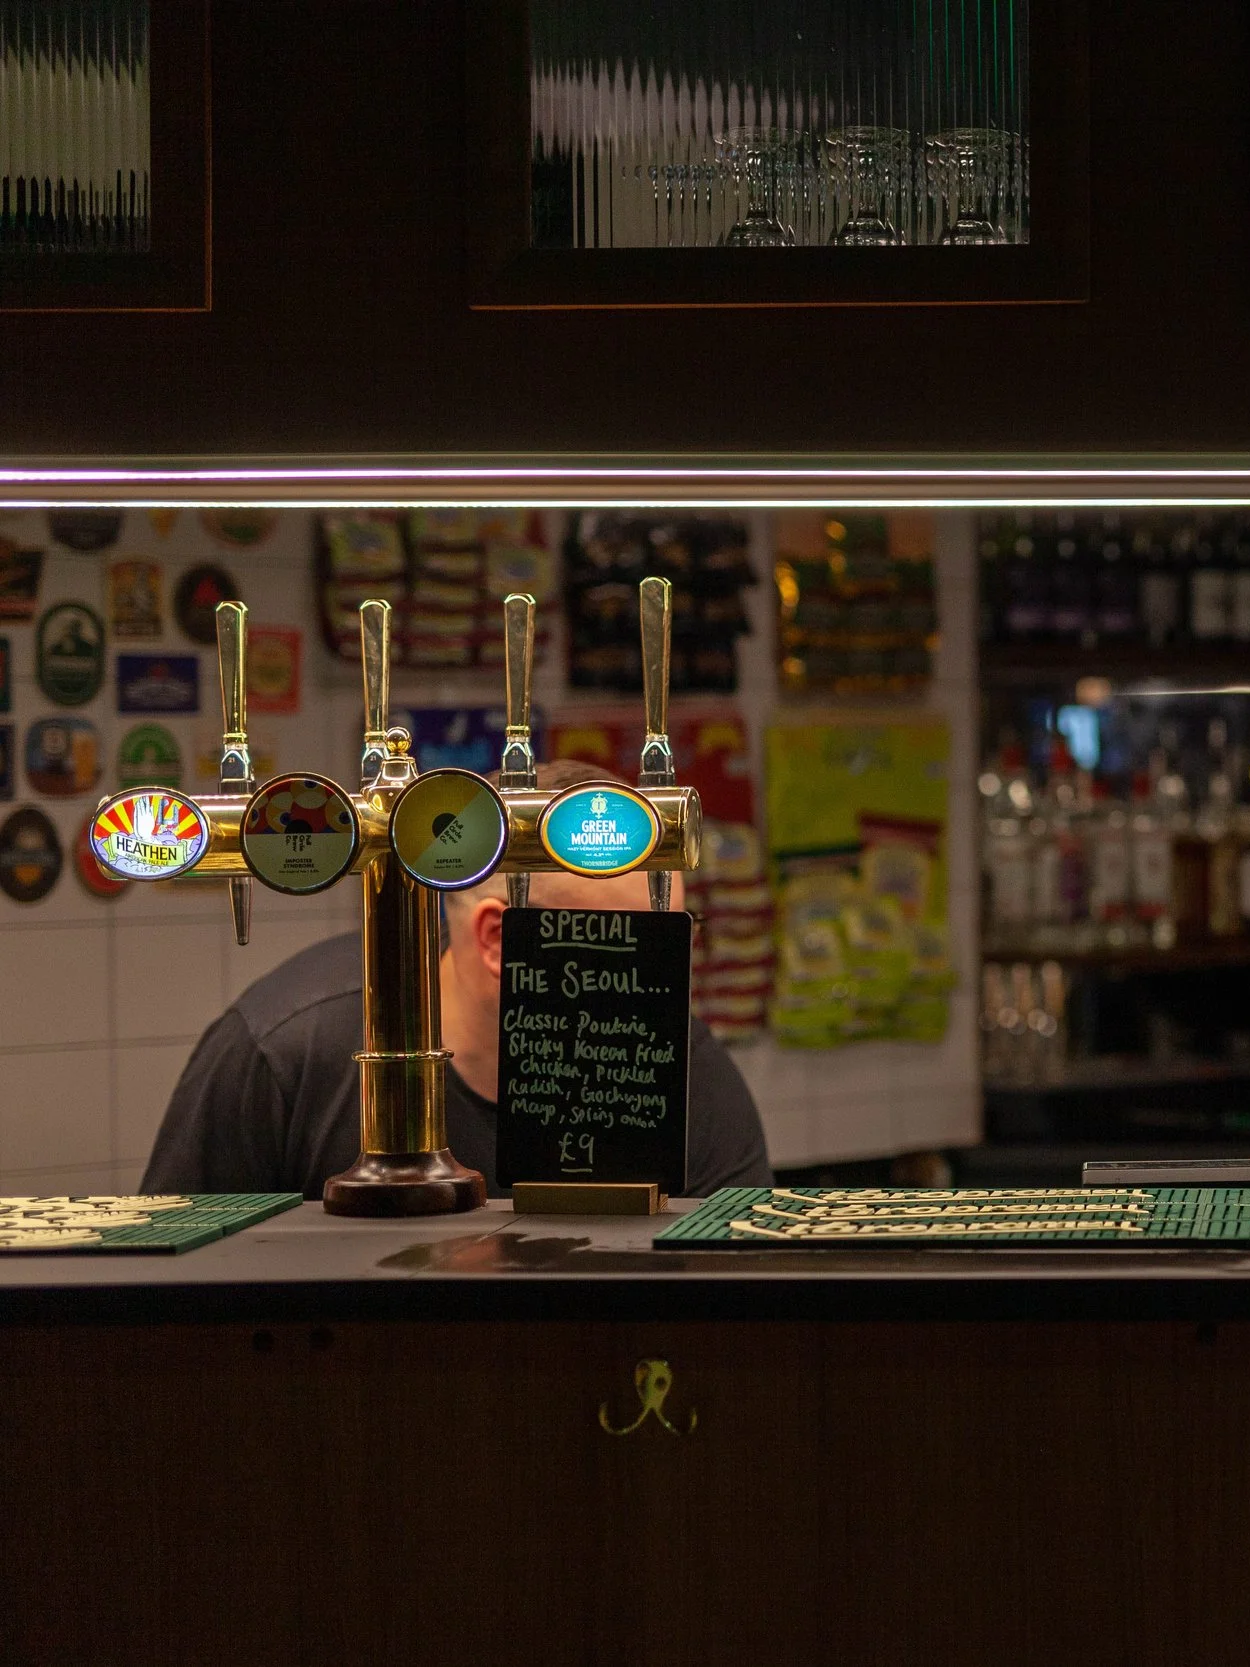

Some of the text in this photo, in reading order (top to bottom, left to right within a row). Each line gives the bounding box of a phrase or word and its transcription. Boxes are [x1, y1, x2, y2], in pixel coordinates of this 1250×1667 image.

[571, 832, 627, 845] MOUNTAIN
[581, 820, 616, 832] GREEN
[116, 836, 177, 861] HEATHEN
[539, 910, 638, 944] SPECIAL
[505, 961, 549, 994] THE
[503, 1004, 656, 1042] Classic Poutine,
[508, 1032, 564, 1060] Sticky
[573, 1039, 628, 1062] Korean
[596, 1064, 656, 1084] Pickled
[507, 1078, 571, 1101] Radish,
[511, 1098, 565, 1126] Mayo,
[558, 1131, 595, 1164] £9
